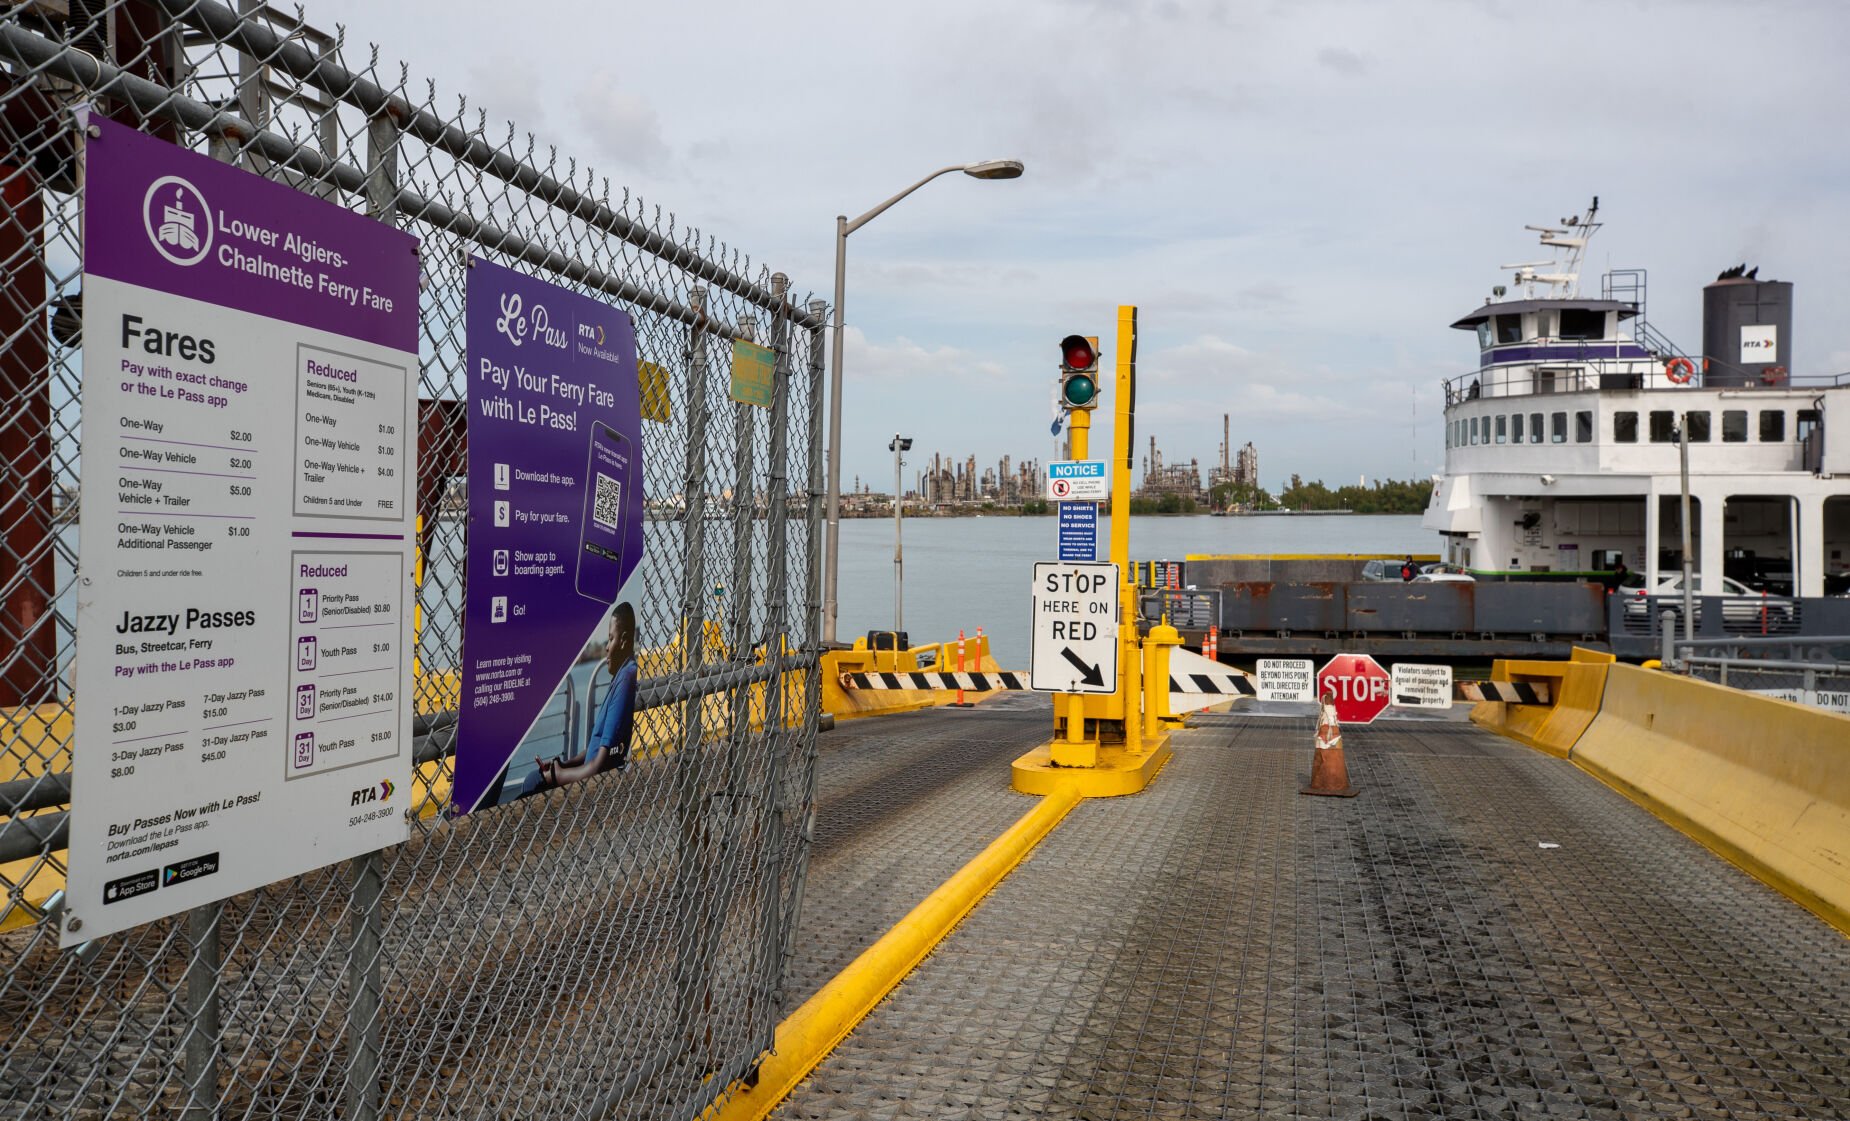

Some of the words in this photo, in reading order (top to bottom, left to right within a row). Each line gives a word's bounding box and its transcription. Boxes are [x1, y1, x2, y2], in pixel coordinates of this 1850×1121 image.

[219, 210, 279, 248] Lower
[283, 232, 348, 268] Algiers-
[218, 244, 313, 289] Chalmette
[318, 274, 358, 306] Ferry
[363, 287, 393, 313] Fare
[496, 293, 528, 346] Le
[532, 305, 568, 349] Pass
[121, 313, 216, 365] Fares
[578, 323, 595, 340] RTA
[121, 359, 144, 377] Pay
[147, 366, 172, 380] with
[176, 371, 207, 385] exact
[209, 376, 248, 394] change
[307, 360, 357, 382] Reduced
[481, 357, 510, 390] Pay
[514, 365, 547, 393] Your
[552, 374, 584, 406] Ferry
[588, 383, 614, 408] Fare
[121, 382, 134, 392] or
[138, 382, 157, 396] the
[160, 385, 174, 398] Le
[178, 388, 205, 403] Pass
[208, 395, 228, 408] app
[305, 412, 337, 428] One-Way
[481, 396, 513, 421] with
[518, 400, 536, 424] Le
[541, 405, 577, 431] Pass!
[120, 416, 163, 433] One-Way
[230, 430, 252, 442] $2.00
[305, 436, 336, 450] One-Way
[337, 440, 360, 451] Vehicle
[119, 447, 162, 463] One-Way
[165, 451, 196, 464] Vehicle
[230, 458, 251, 469] $2.00
[1056, 465, 1098, 476] NOTICE
[119, 477, 162, 492] One-Way
[515, 469, 549, 483] Download
[550, 473, 560, 484] the
[561, 476, 575, 487] app.
[230, 485, 251, 496] $5.00
[118, 492, 152, 504] Vehicle
[163, 495, 191, 506] Trailer
[378, 500, 393, 509] FREE
[515, 510, 528, 523] Pay
[529, 511, 539, 521] for
[540, 512, 555, 524] your
[556, 512, 570, 523] fare.
[118, 523, 161, 536] One-Way
[163, 524, 195, 535] Vehicle
[228, 526, 250, 537] $1.00
[117, 538, 164, 549] Additional
[167, 539, 213, 551] Passenger
[514, 551, 533, 562] Show
[535, 553, 548, 563] app
[549, 551, 556, 561] to
[300, 564, 347, 577] Reduced
[514, 564, 544, 577] boarding
[545, 565, 565, 577] agent.
[1046, 573, 1106, 593] STOP
[513, 605, 526, 616] Go!
[1043, 601, 1079, 613] HERE
[1089, 602, 1108, 614] ON
[116, 611, 180, 636] Jazzy
[186, 608, 255, 629] Passes
[1052, 621, 1097, 641] RED
[115, 644, 138, 655] Bus,
[141, 641, 187, 653] Streetcar,
[189, 639, 213, 649] Ferry
[115, 666, 134, 678] Pay
[137, 663, 158, 675] with
[161, 662, 176, 672] the
[179, 661, 191, 671] Le
[193, 659, 215, 669] Pass
[217, 658, 234, 668] app
[476, 659, 492, 669] Learn
[492, 658, 506, 667] more
[514, 654, 532, 665] visiting
[1263, 661, 1271, 669] DO
[1272, 661, 1282, 669] NOT
[1282, 661, 1306, 669] PROCEED
[1261, 671, 1281, 679] BEYOND
[1282, 671, 1293, 679] THIS
[1294, 671, 1309, 680] POINT
[343, 687, 357, 695] Pass
[475, 684, 493, 694] calling
[493, 683, 503, 691] our
[1261, 681, 1276, 690] UNTIL
[1276, 681, 1300, 690] DIRECTED
[1301, 682, 1309, 690] BY
[1324, 675, 1386, 702] STOP
[203, 694, 225, 703] 7-Day
[227, 691, 247, 701] Jazzy
[248, 689, 265, 698] Pass
[1270, 692, 1299, 700] ATTENDANT
[1817, 693, 1829, 705] DO
[1832, 694, 1848, 706] NOT
[113, 705, 139, 716] 1-Day
[141, 702, 164, 713] Jazzy
[166, 700, 185, 709] Pass
[203, 708, 227, 719] $15.00
[113, 721, 136, 733] $3.00
[202, 735, 228, 747] 31-Day
[229, 732, 249, 743] Jazzy
[251, 730, 267, 739] Pass
[112, 751, 137, 762] 3-Day
[139, 747, 163, 757] Jazzy
[165, 743, 184, 752] Pass
[201, 751, 226, 763] $45.00
[111, 766, 135, 778] $8.00
[351, 787, 376, 807] RTA
[108, 823, 130, 837] Buy
[133, 814, 171, 831] Passes
[173, 808, 197, 821] Now
[199, 801, 220, 815] with
[222, 798, 234, 810] Le
[236, 791, 261, 807] Pass!
[107, 832, 148, 851] Download
[150, 829, 162, 840] the
[163, 826, 173, 837] Le
[175, 822, 193, 835] Pass
[194, 819, 210, 831] app.
[106, 838, 179, 864] norta.com/lepass
[180, 868, 202, 878] Google
[203, 863, 216, 872] Play
[119, 886, 135, 897] App
[136, 881, 155, 892] Store
